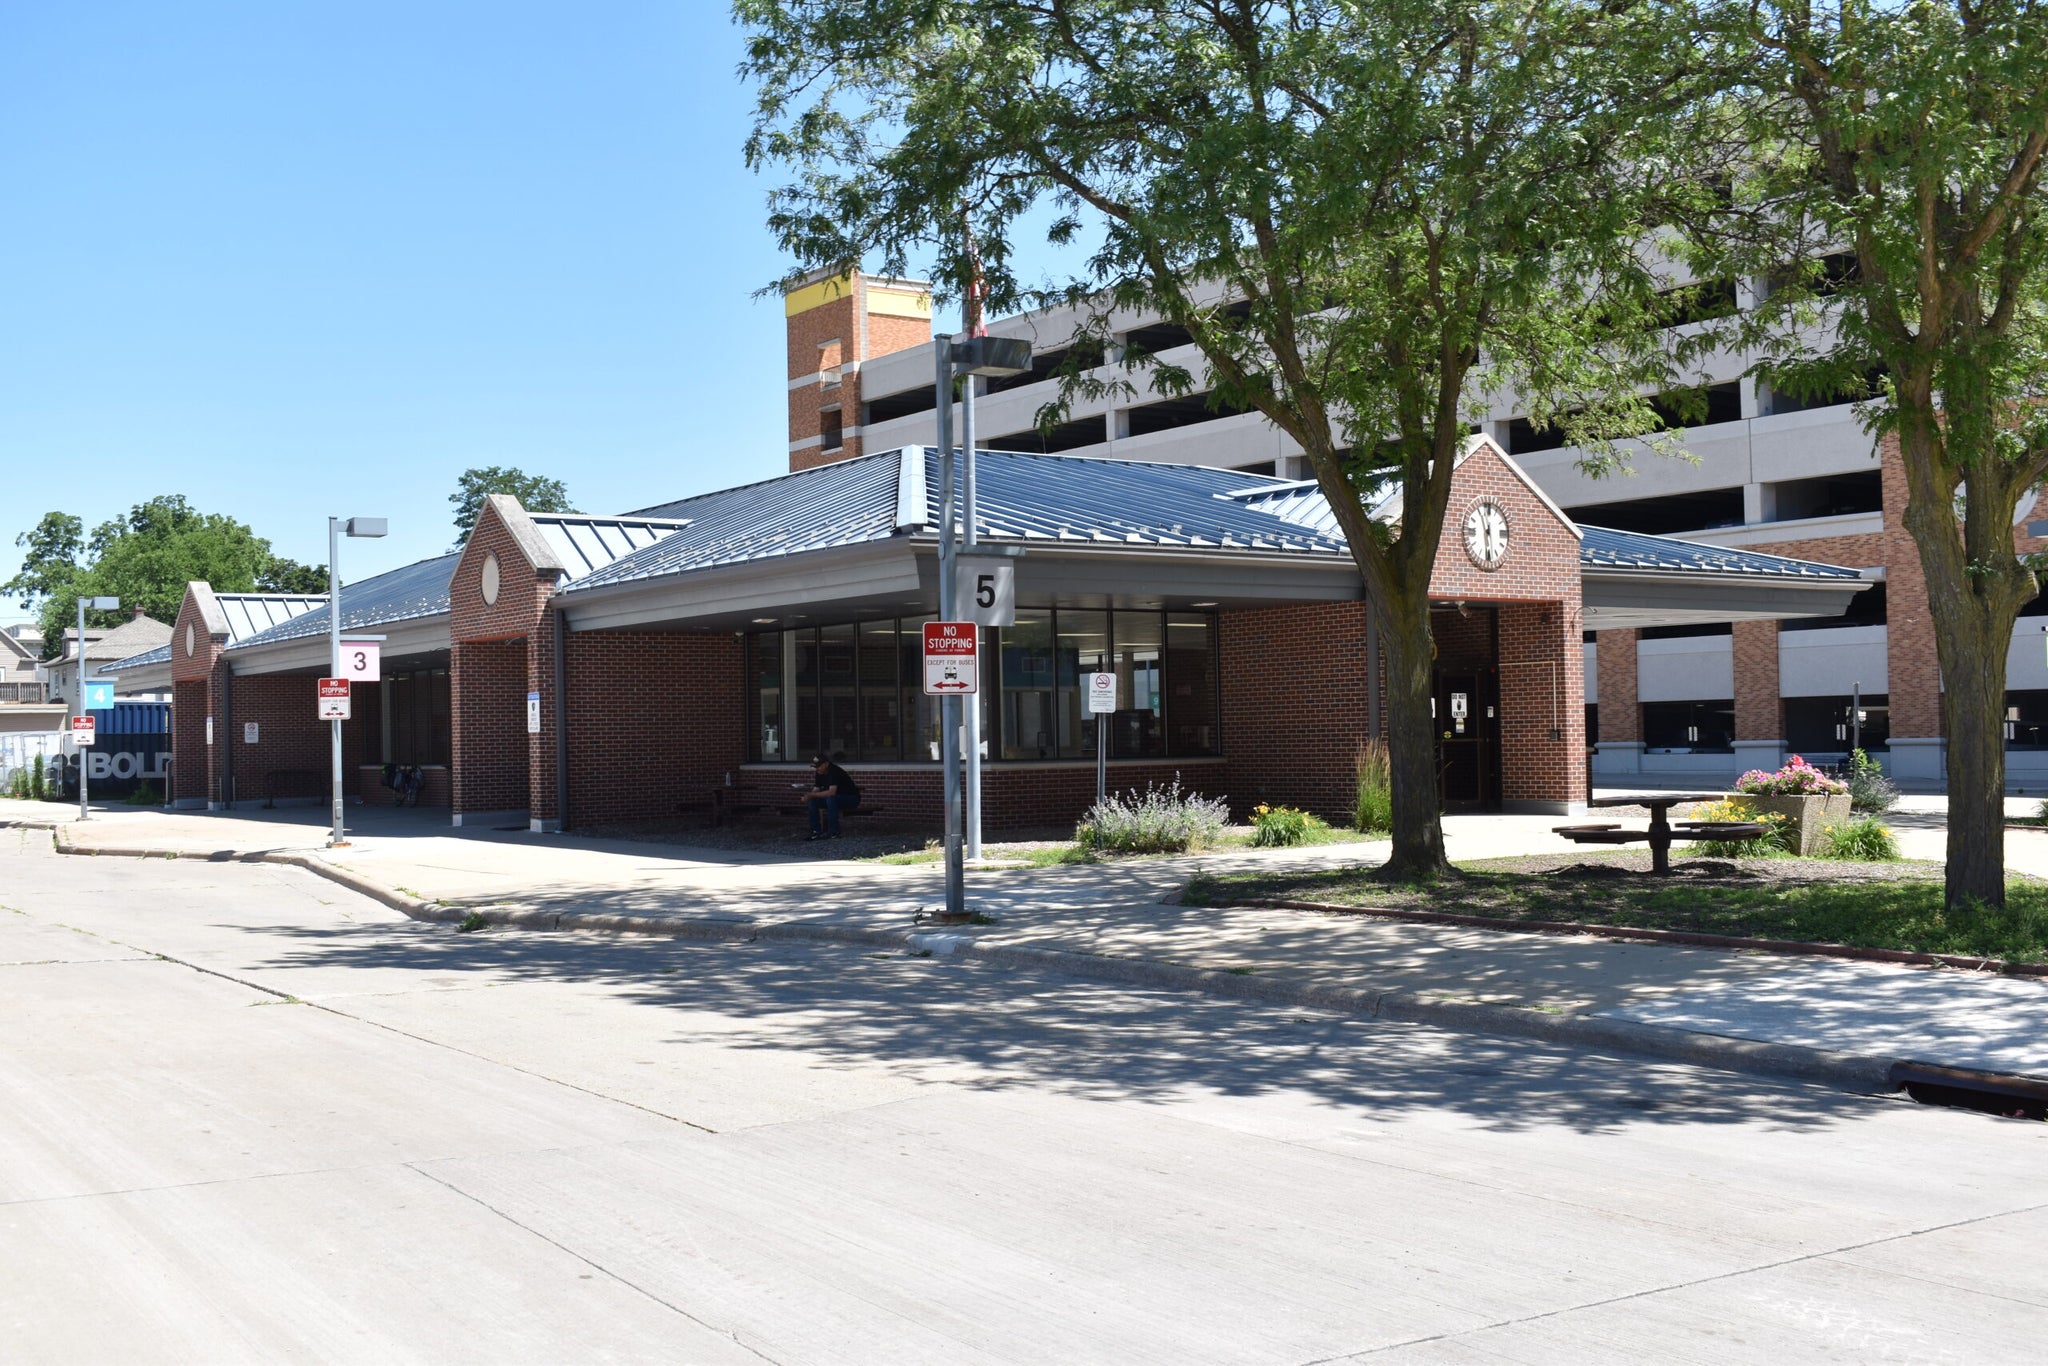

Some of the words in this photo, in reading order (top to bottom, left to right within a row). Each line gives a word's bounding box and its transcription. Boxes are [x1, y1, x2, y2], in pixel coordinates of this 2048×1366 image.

[976, 575, 996, 609] 5
[943, 626, 957, 636] NO
[928, 638, 973, 649] STOPPING
[354, 652, 366, 671] 3
[94, 688, 105, 702] 4
[88, 752, 173, 779] BOLD
